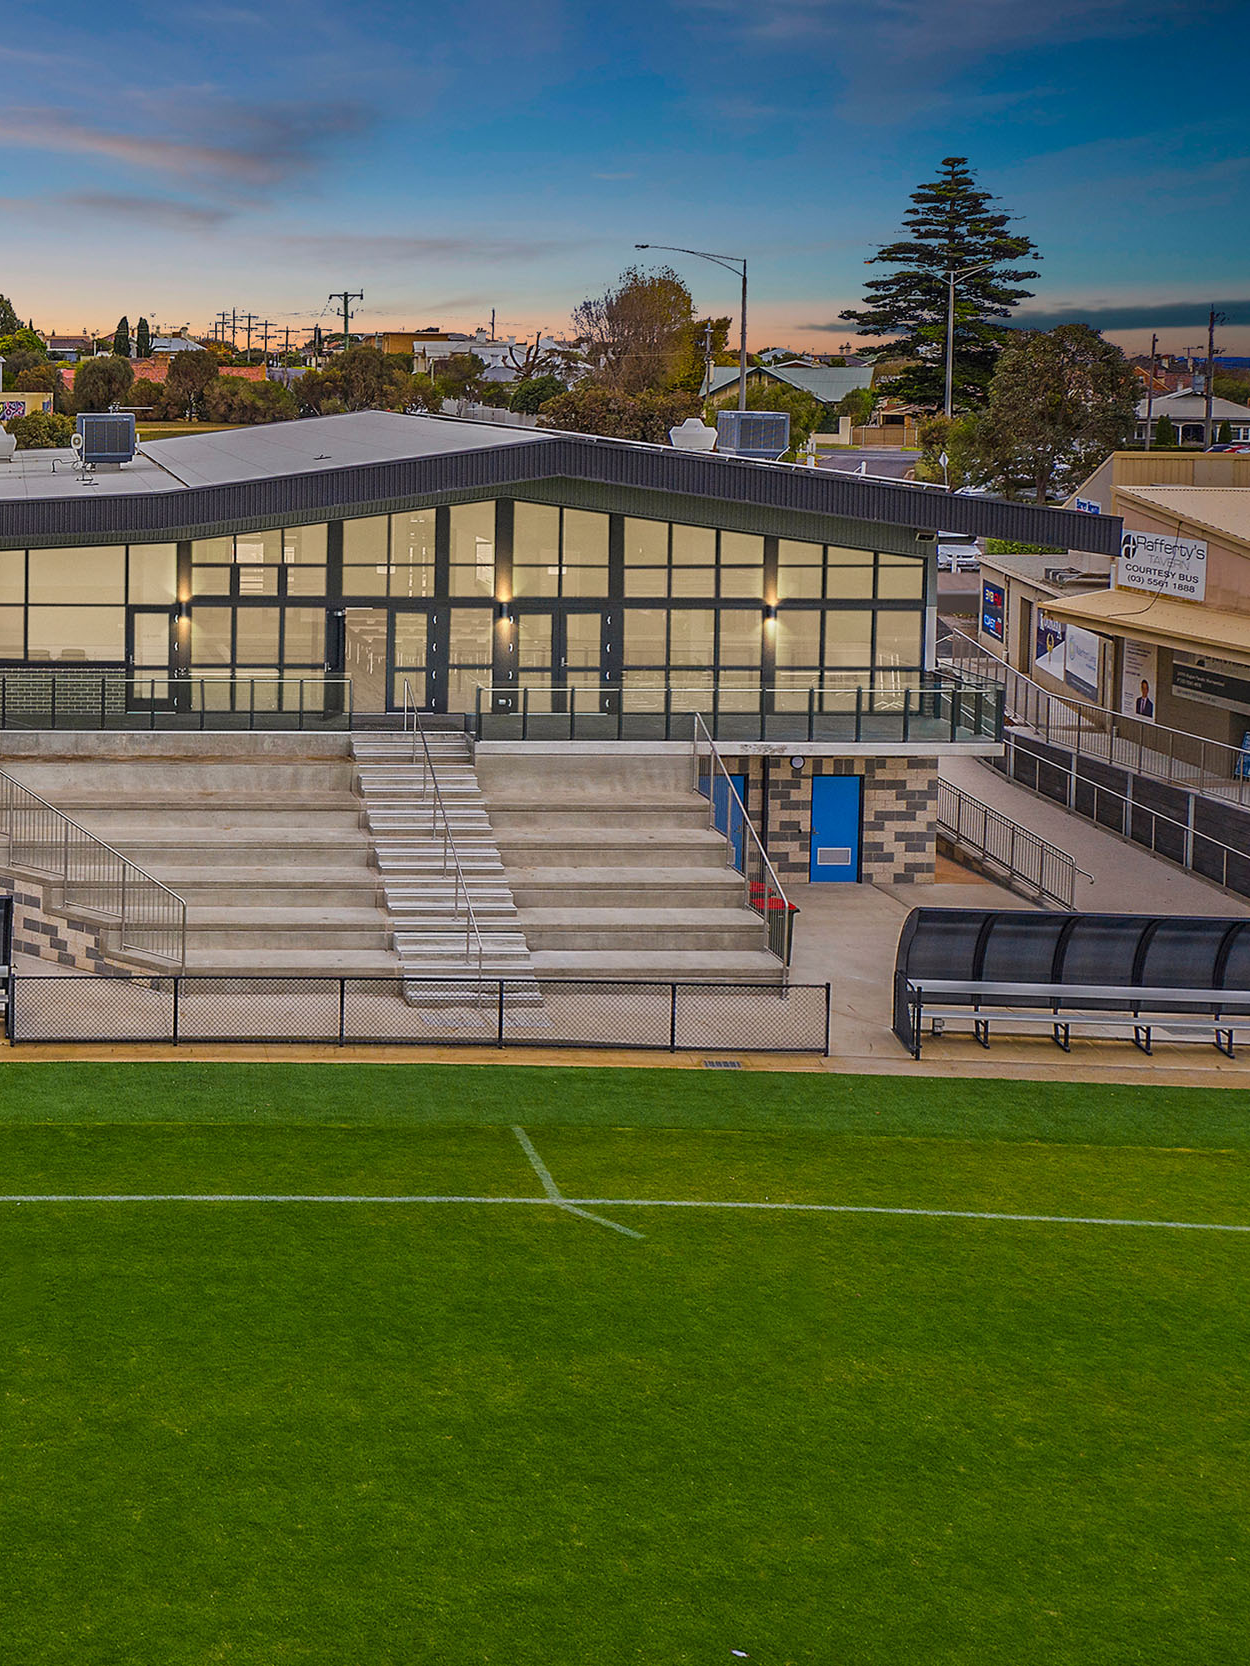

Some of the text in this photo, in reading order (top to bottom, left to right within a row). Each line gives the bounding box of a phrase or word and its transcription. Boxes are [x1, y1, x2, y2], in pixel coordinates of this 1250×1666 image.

[1136, 535, 1206, 561] Rafferty's
[1148, 554, 1190, 571] TAVERN
[1125, 563, 1199, 584] COURTESY BUS
[1127, 574, 1195, 593] (03) 5561 1888
